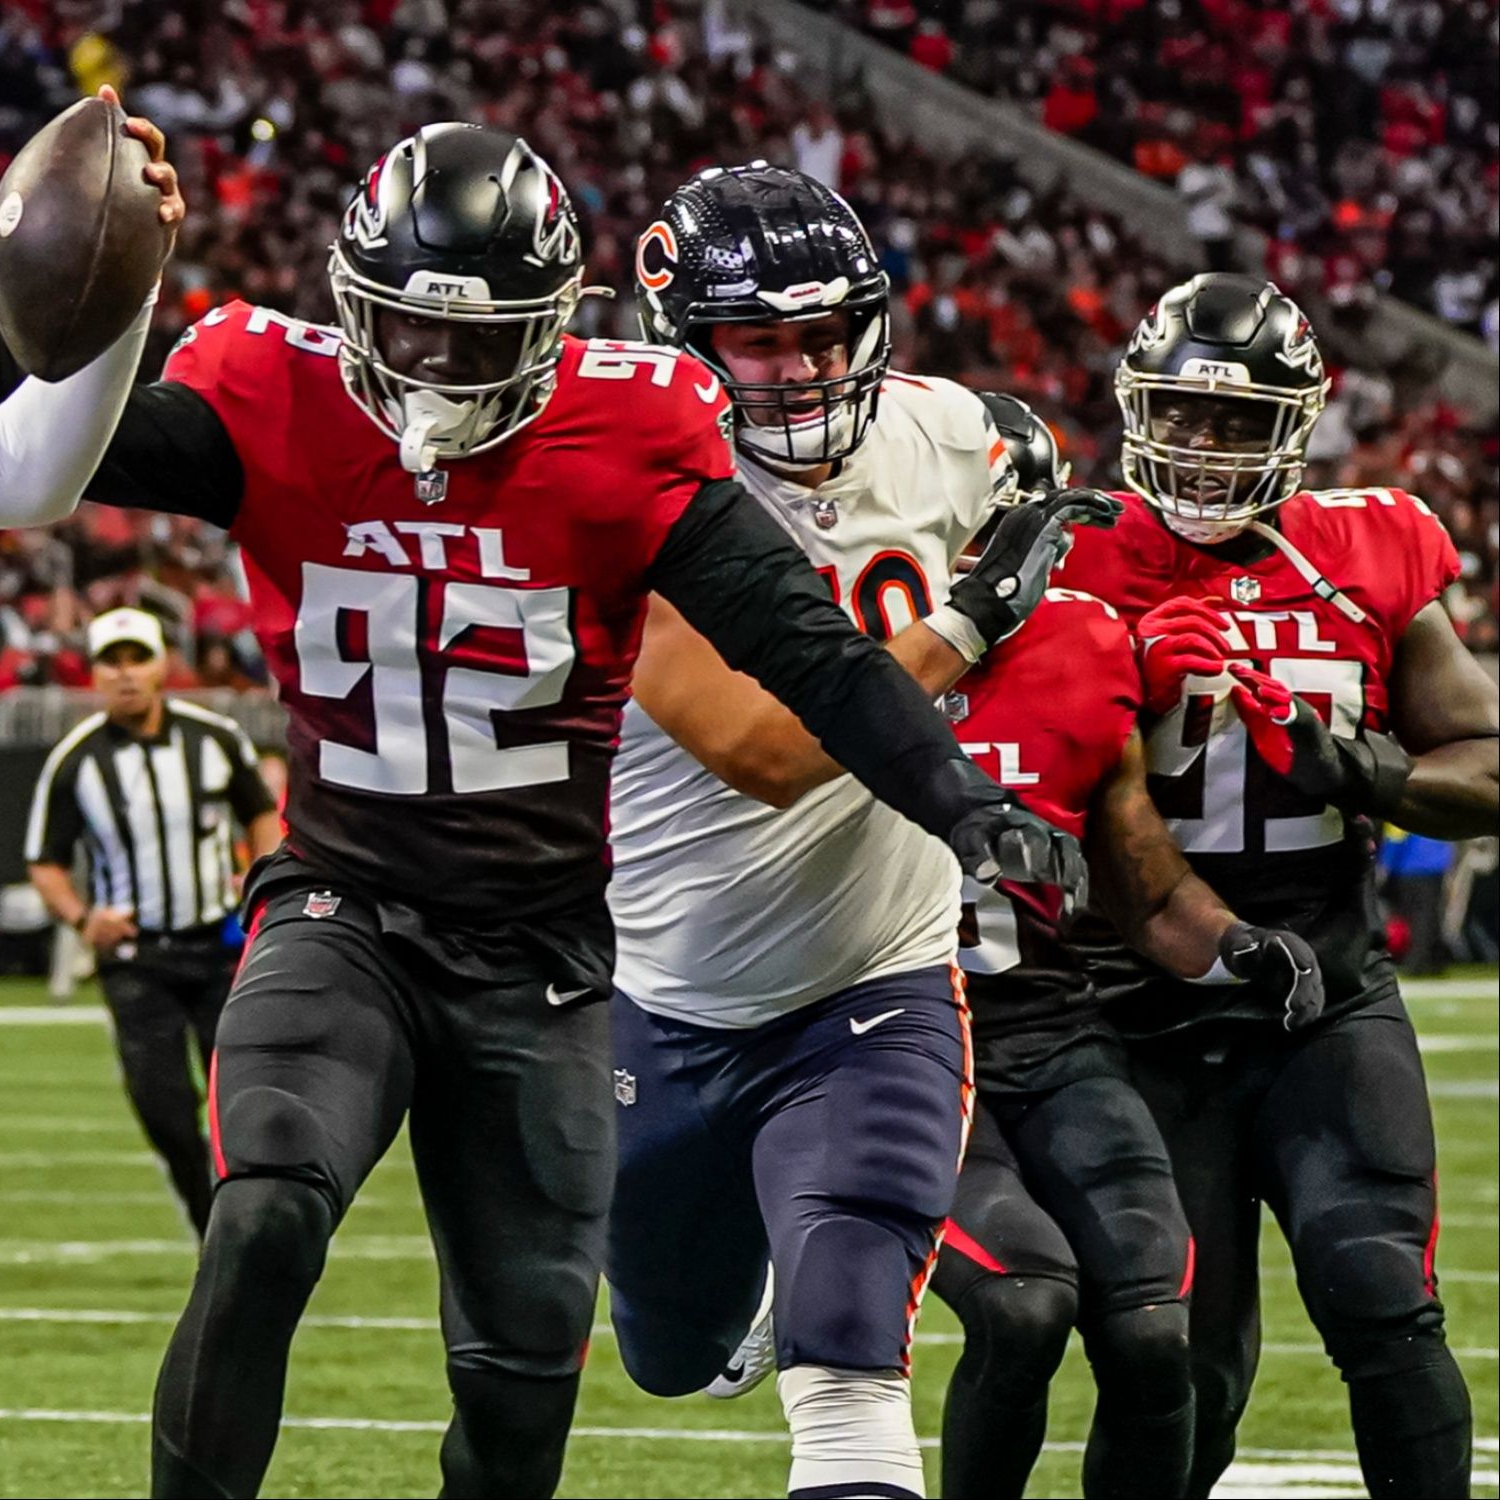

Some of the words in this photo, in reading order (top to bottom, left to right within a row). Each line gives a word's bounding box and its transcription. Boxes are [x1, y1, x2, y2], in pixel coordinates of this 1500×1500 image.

[635, 220, 678, 292] C
[427, 281, 468, 298] ATL
[1198, 364, 1232, 377] ATL
[343, 520, 530, 581] ATL
[295, 562, 576, 795] 92
